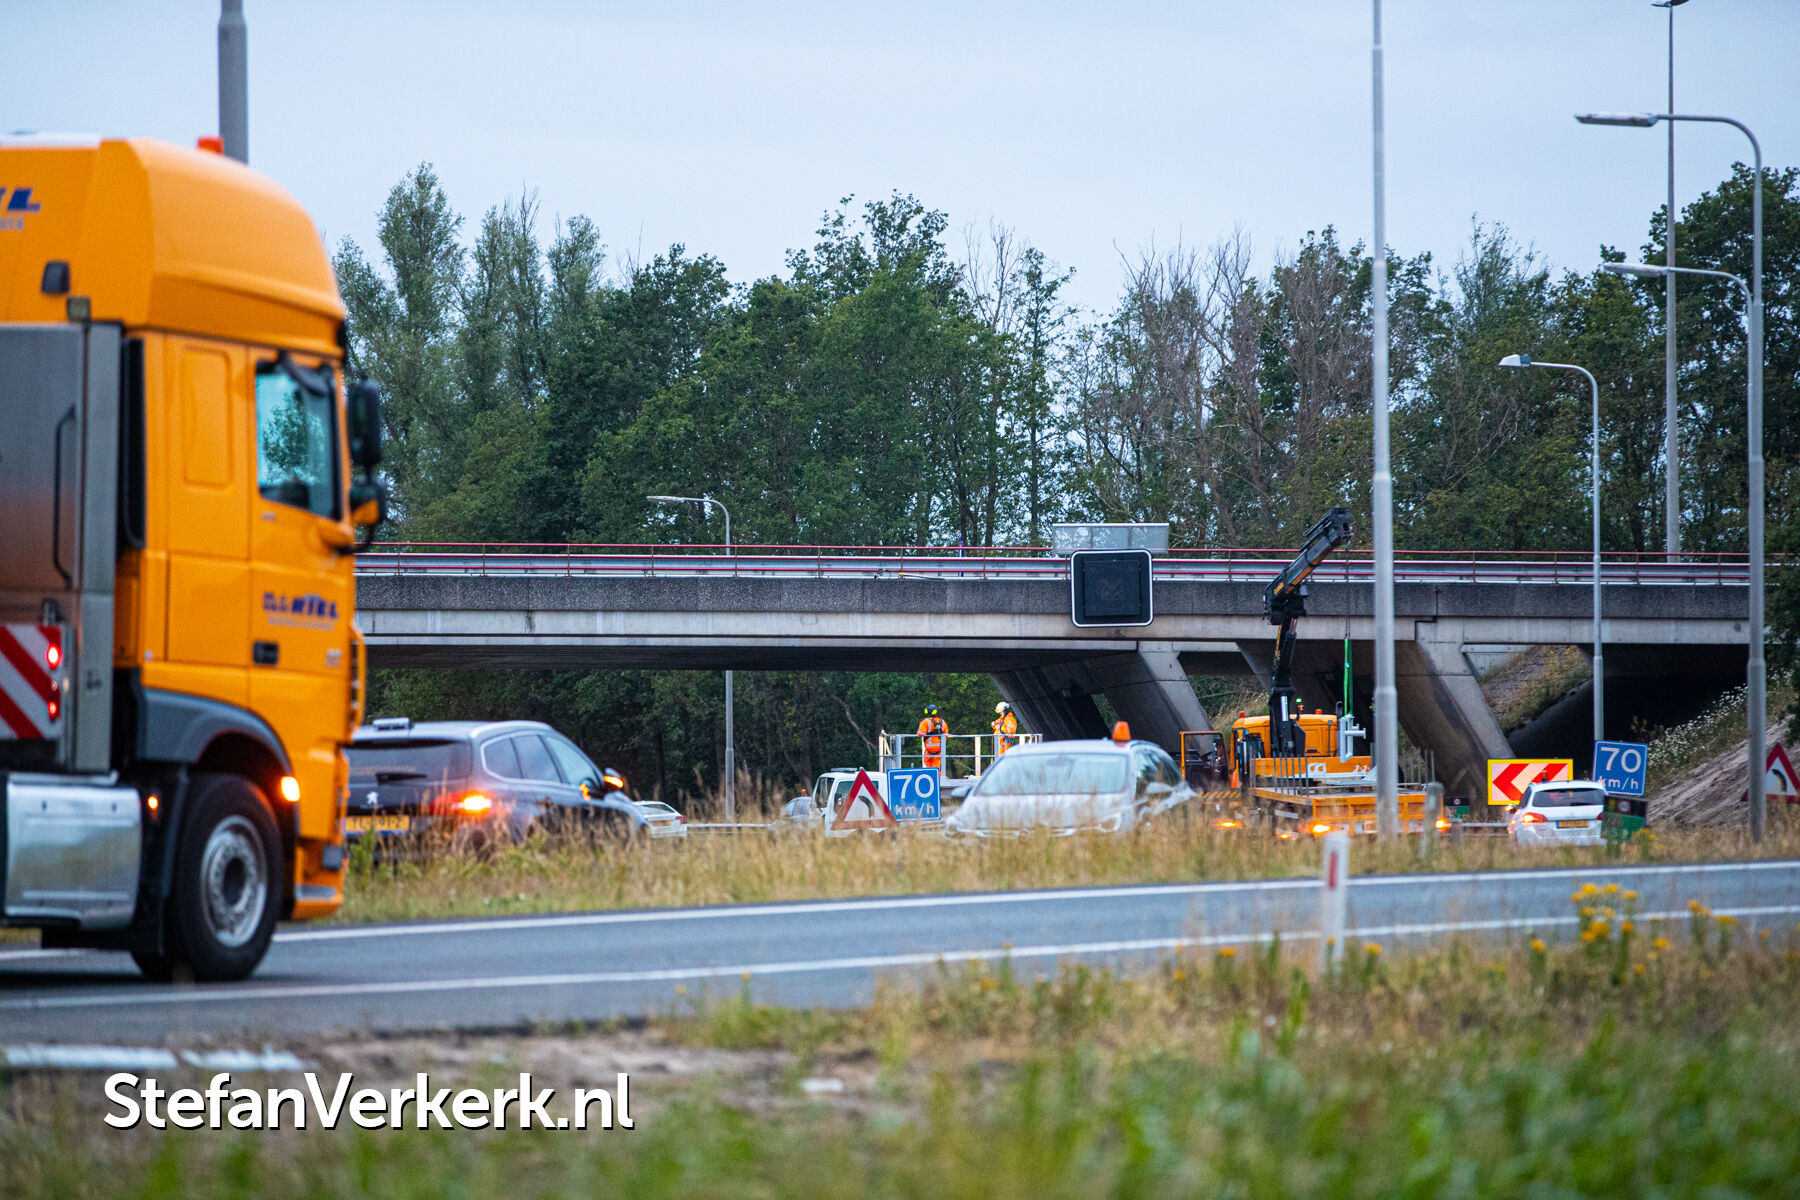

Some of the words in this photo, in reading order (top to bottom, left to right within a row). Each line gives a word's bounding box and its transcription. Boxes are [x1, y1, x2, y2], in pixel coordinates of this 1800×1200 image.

[1601, 746, 1641, 773] 70
[893, 774, 934, 799] 70
[1598, 776, 1639, 790] km/h
[895, 803, 934, 816] km/h
